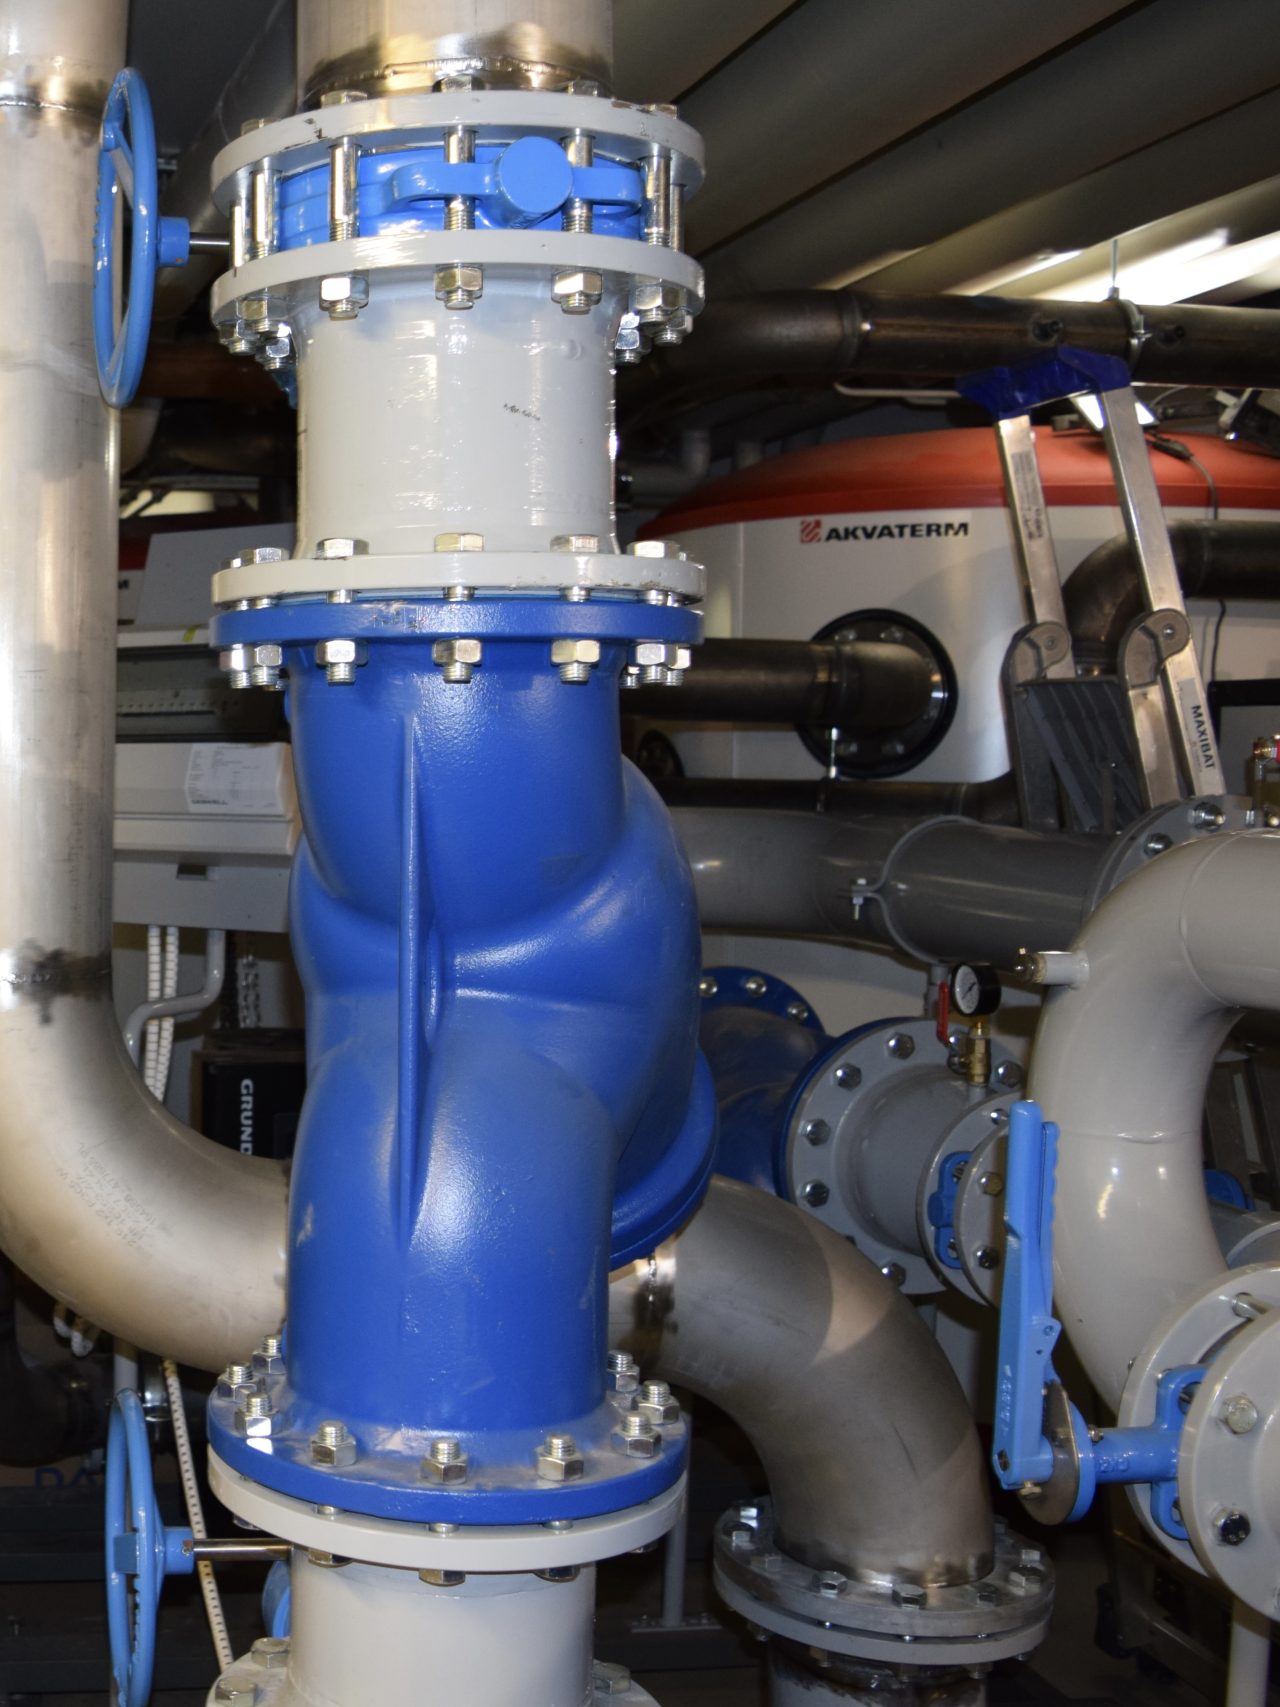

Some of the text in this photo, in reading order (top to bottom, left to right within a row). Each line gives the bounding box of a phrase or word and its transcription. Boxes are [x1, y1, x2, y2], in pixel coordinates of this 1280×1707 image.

[824, 522, 970, 542] AKVATERM
[1191, 704, 1216, 769] MAXIBAT
[241, 1078, 254, 1156] GRUND
